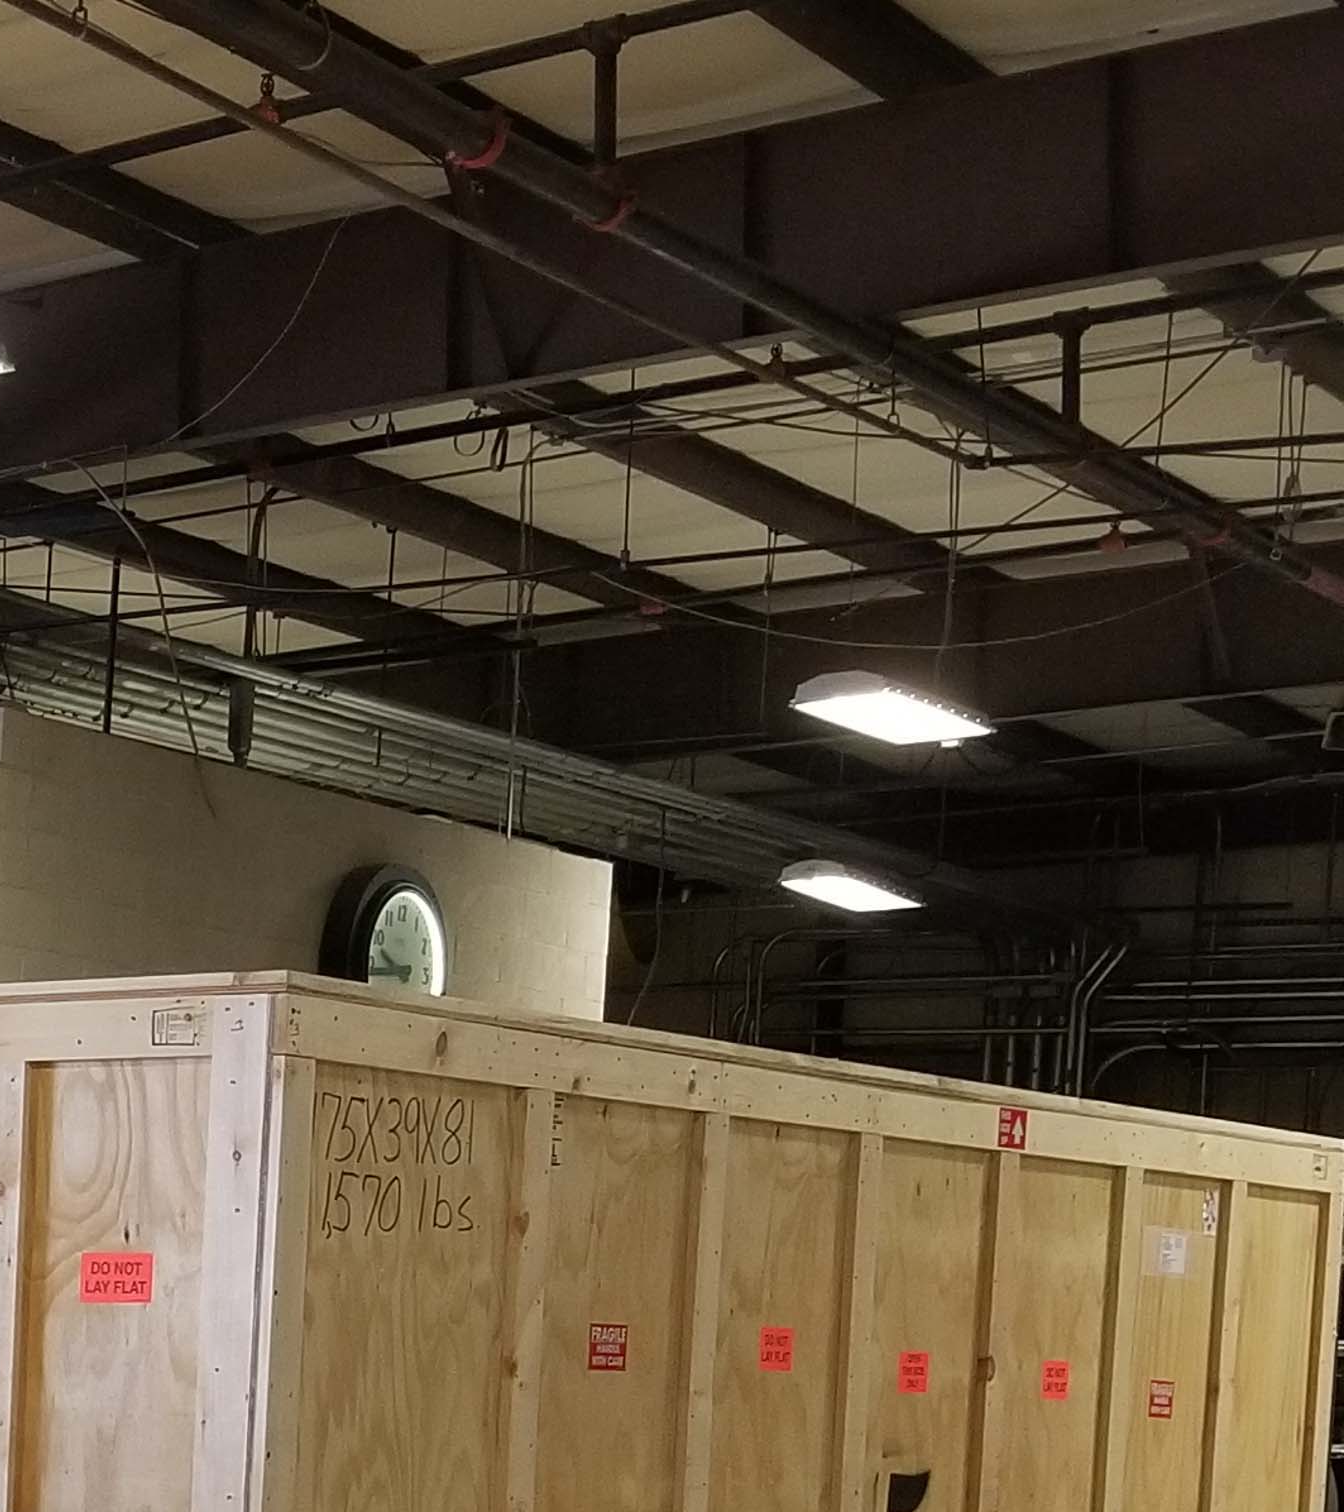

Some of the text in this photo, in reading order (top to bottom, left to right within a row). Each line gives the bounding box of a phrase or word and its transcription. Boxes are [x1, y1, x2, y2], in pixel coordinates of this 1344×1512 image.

[383, 910, 393, 927] 11
[397, 905, 407, 922] 12
[322, 1171, 403, 1239] 1,570
[91, 1261, 143, 1277] DO NOT
[85, 1280, 147, 1295] LAY FLAT
[592, 1326, 626, 1343] FRAGILE
